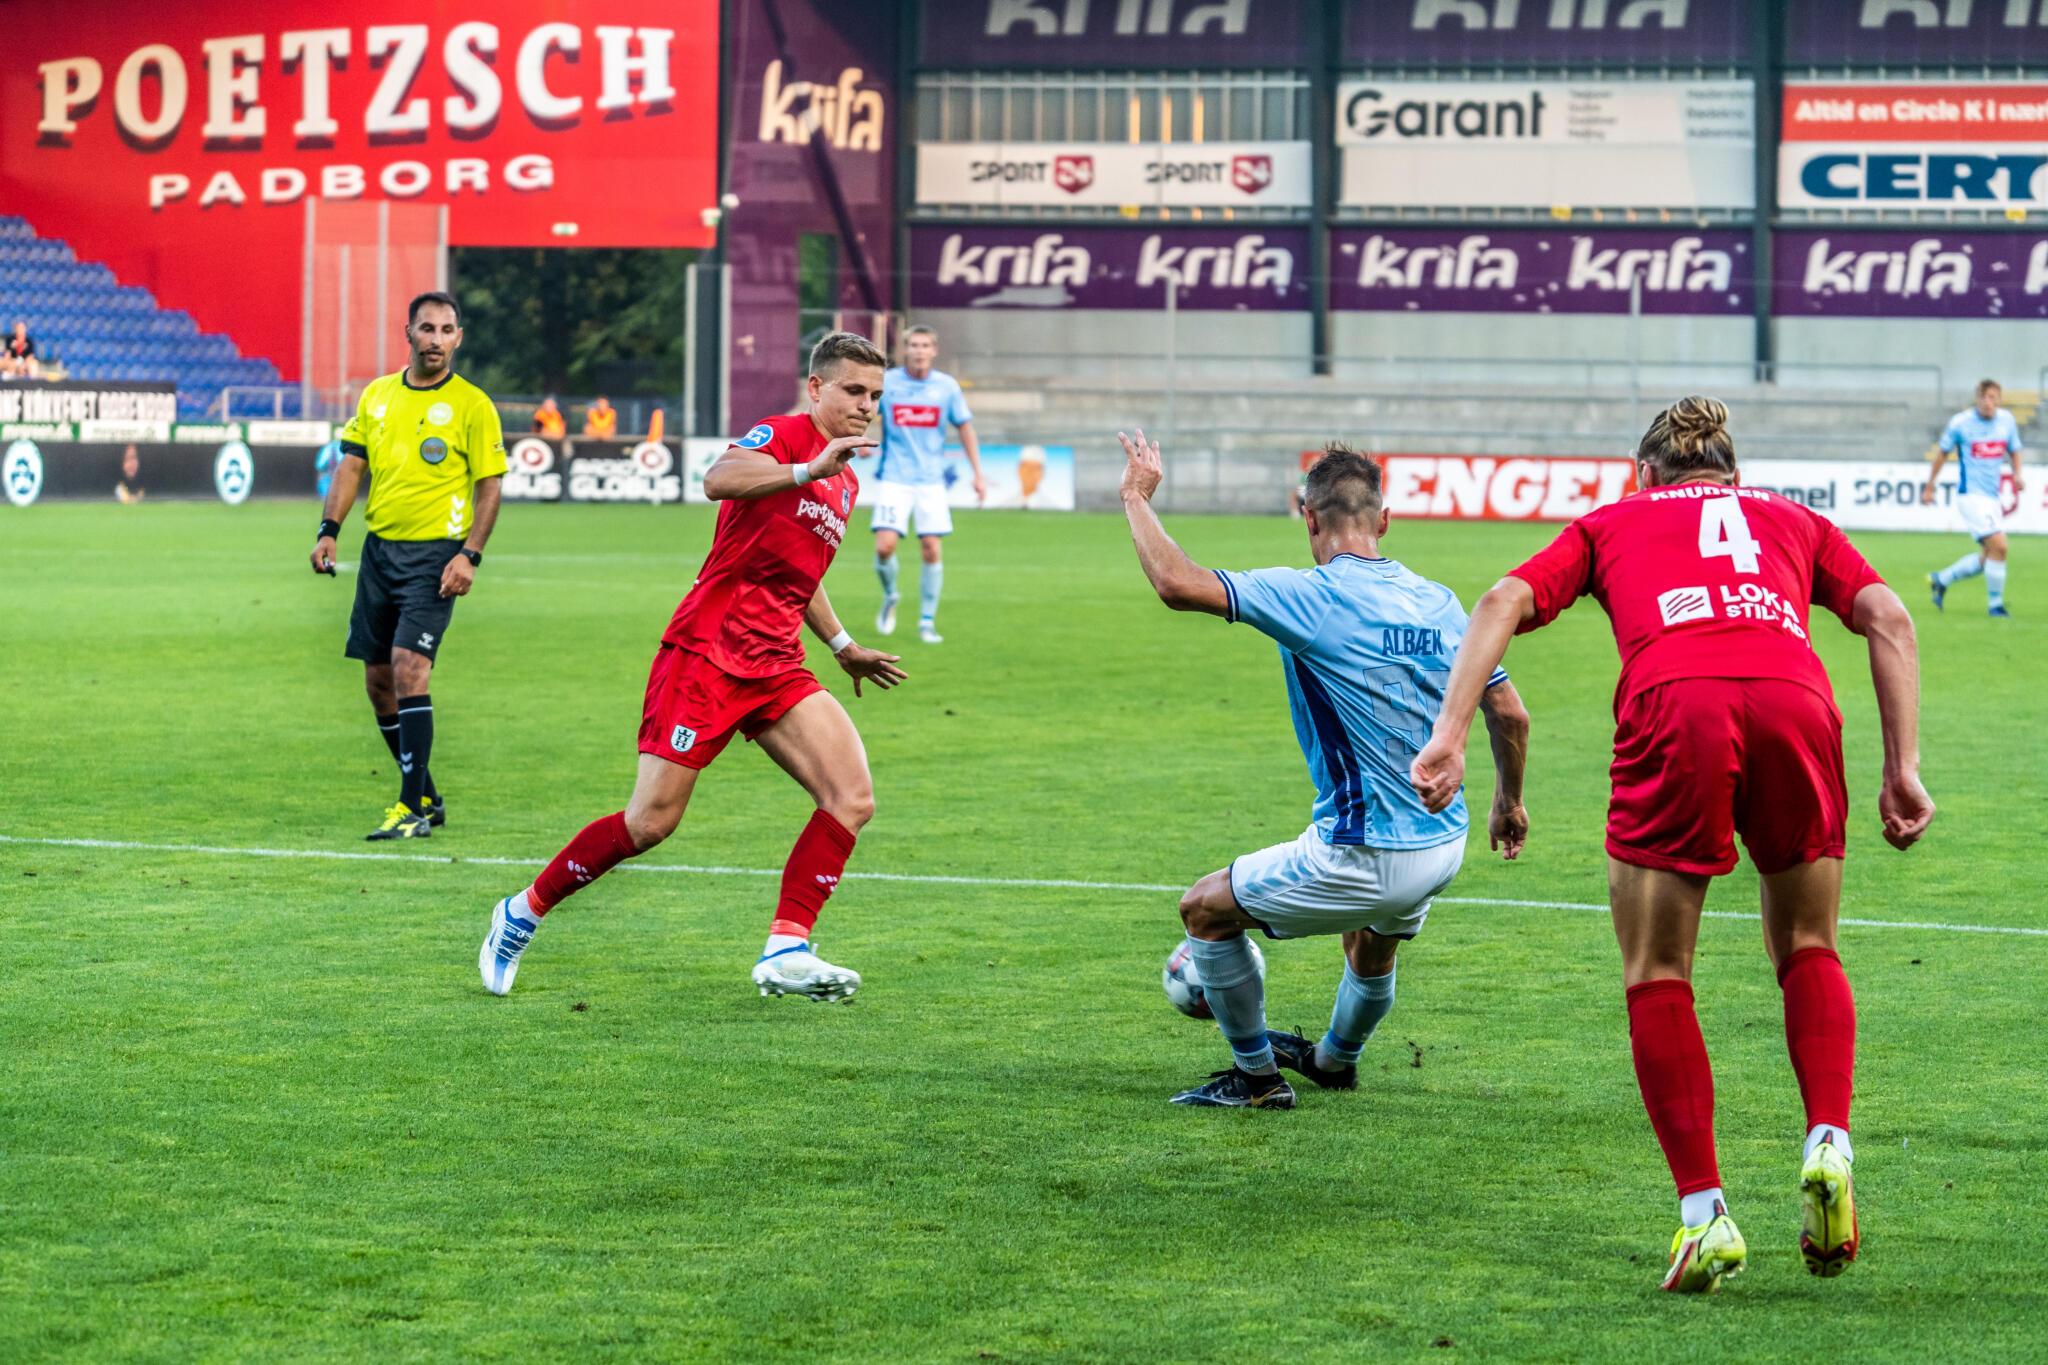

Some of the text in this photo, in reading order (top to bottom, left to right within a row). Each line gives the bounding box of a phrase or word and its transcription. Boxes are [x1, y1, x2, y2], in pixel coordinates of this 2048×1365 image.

[36, 22, 676, 138] POETZSCH
[758, 60, 885, 151] krifa
[1346, 89, 1545, 138] Garant
[1796, 98, 1854, 122] Altid
[1858, 103, 1888, 122] en
[1892, 98, 1960, 122] Circle
[1964, 99, 1983, 121] K
[149, 154, 555, 209] PADBORG
[970, 162, 1047, 183] SPORT
[1145, 162, 1225, 185] SPORT
[938, 235, 1091, 287] krifa
[1136, 235, 1293, 289] krifa
[1358, 236, 1518, 289] krifa
[1566, 237, 1731, 291] krifa
[1803, 240, 1972, 294] krifa
[569, 474, 681, 500] GLOBUS
[1650, 486, 1770, 502] KNUDSEN
[1854, 480, 1957, 505] SPORT
[1698, 495, 1762, 575] 4
[1382, 628, 1444, 656] ALBÆK
